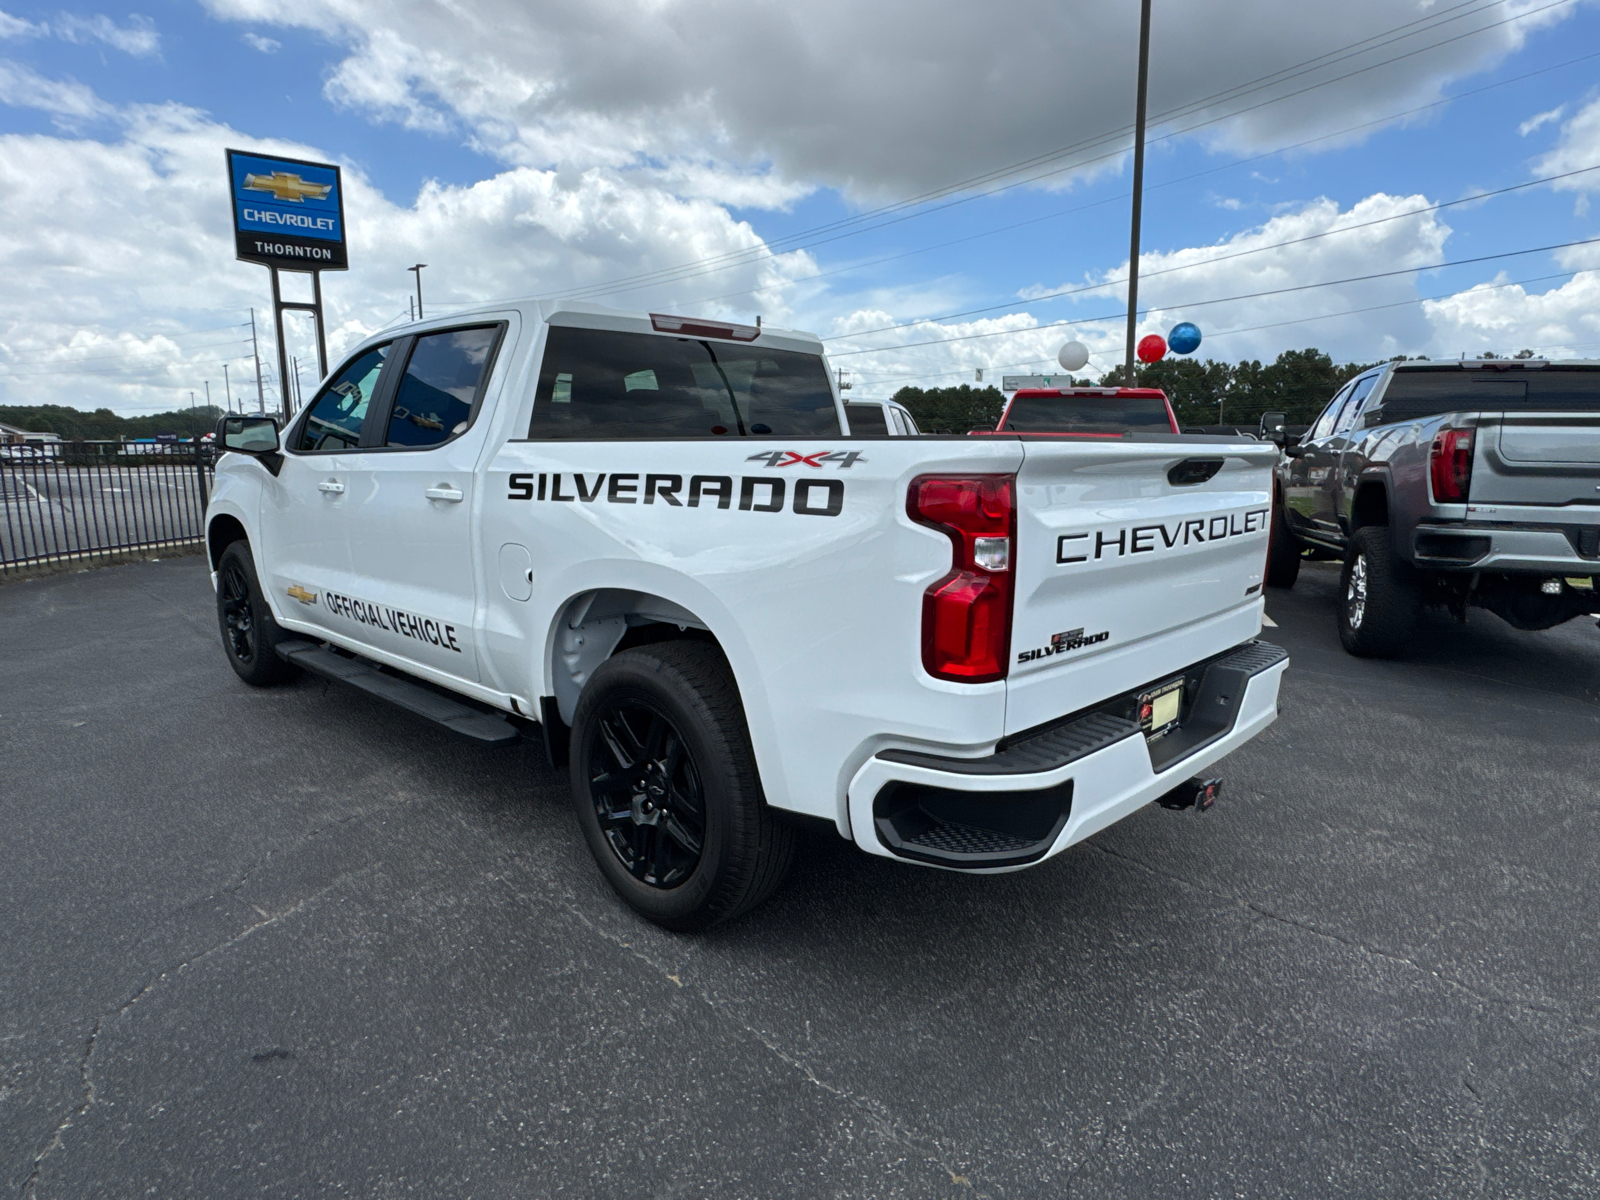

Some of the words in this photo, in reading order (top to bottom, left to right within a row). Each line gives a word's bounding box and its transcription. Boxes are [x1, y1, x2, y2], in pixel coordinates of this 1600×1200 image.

[243, 208, 335, 231] CHEVROLET
[254, 241, 332, 259] THORNTON
[508, 473, 845, 517] SILVERADO
[1056, 508, 1270, 564] CHEVROLET
[326, 592, 389, 630] OFFICIAL
[385, 608, 462, 653] VEHICLE
[1017, 631, 1110, 664] SILVERADO
